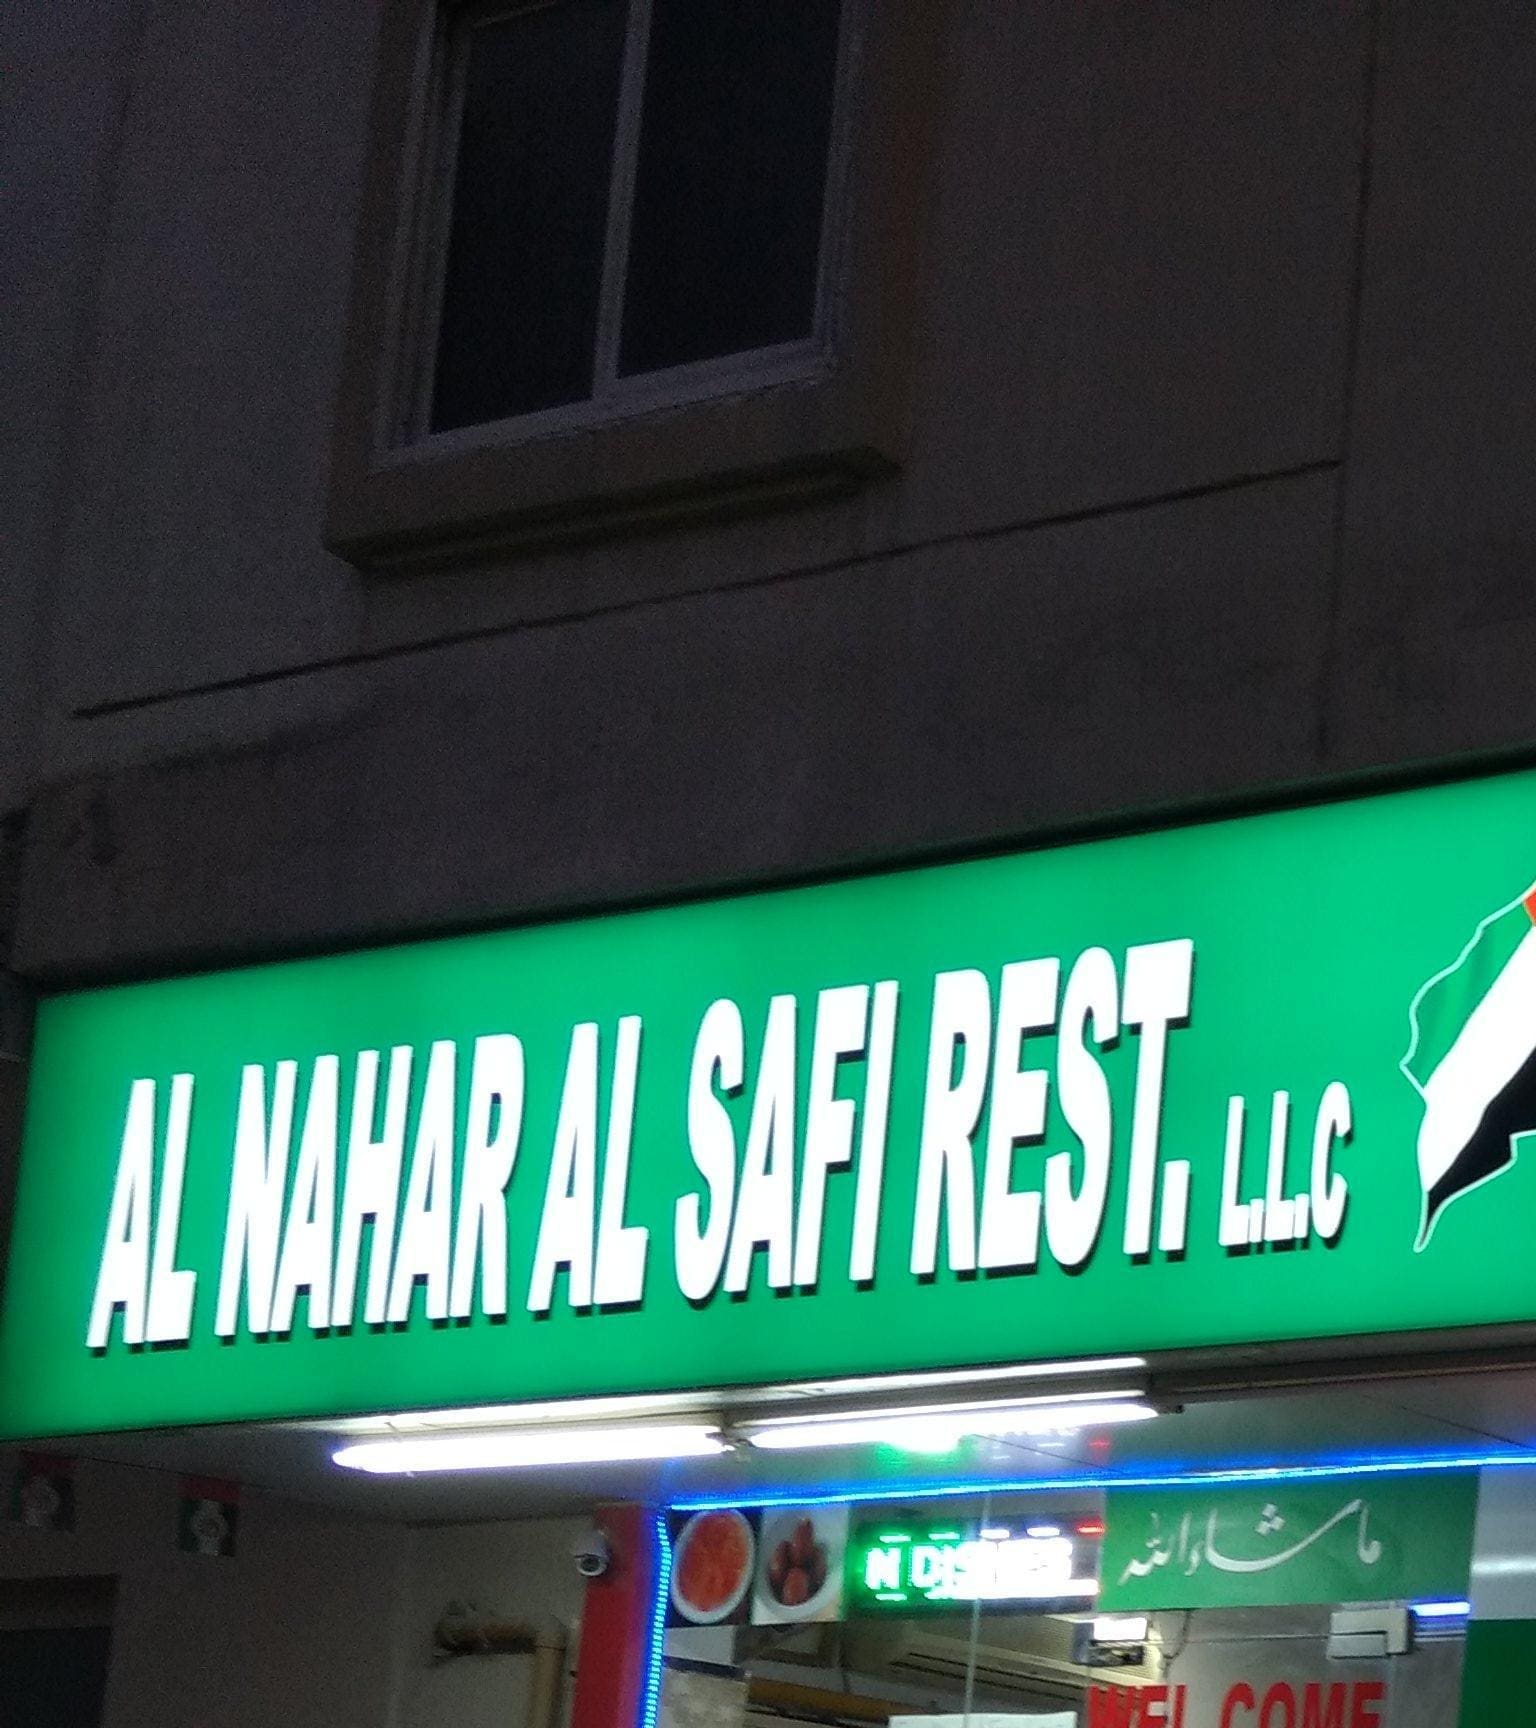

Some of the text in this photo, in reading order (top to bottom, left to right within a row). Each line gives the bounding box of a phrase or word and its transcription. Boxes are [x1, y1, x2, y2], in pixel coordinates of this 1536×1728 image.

[86, 1072, 197, 1349] AL
[215, 1033, 525, 1337] NAHAR
[527, 1014, 649, 1312] AL
[674, 979, 899, 1301] SAFI
[910, 938, 1194, 1275] REST.
